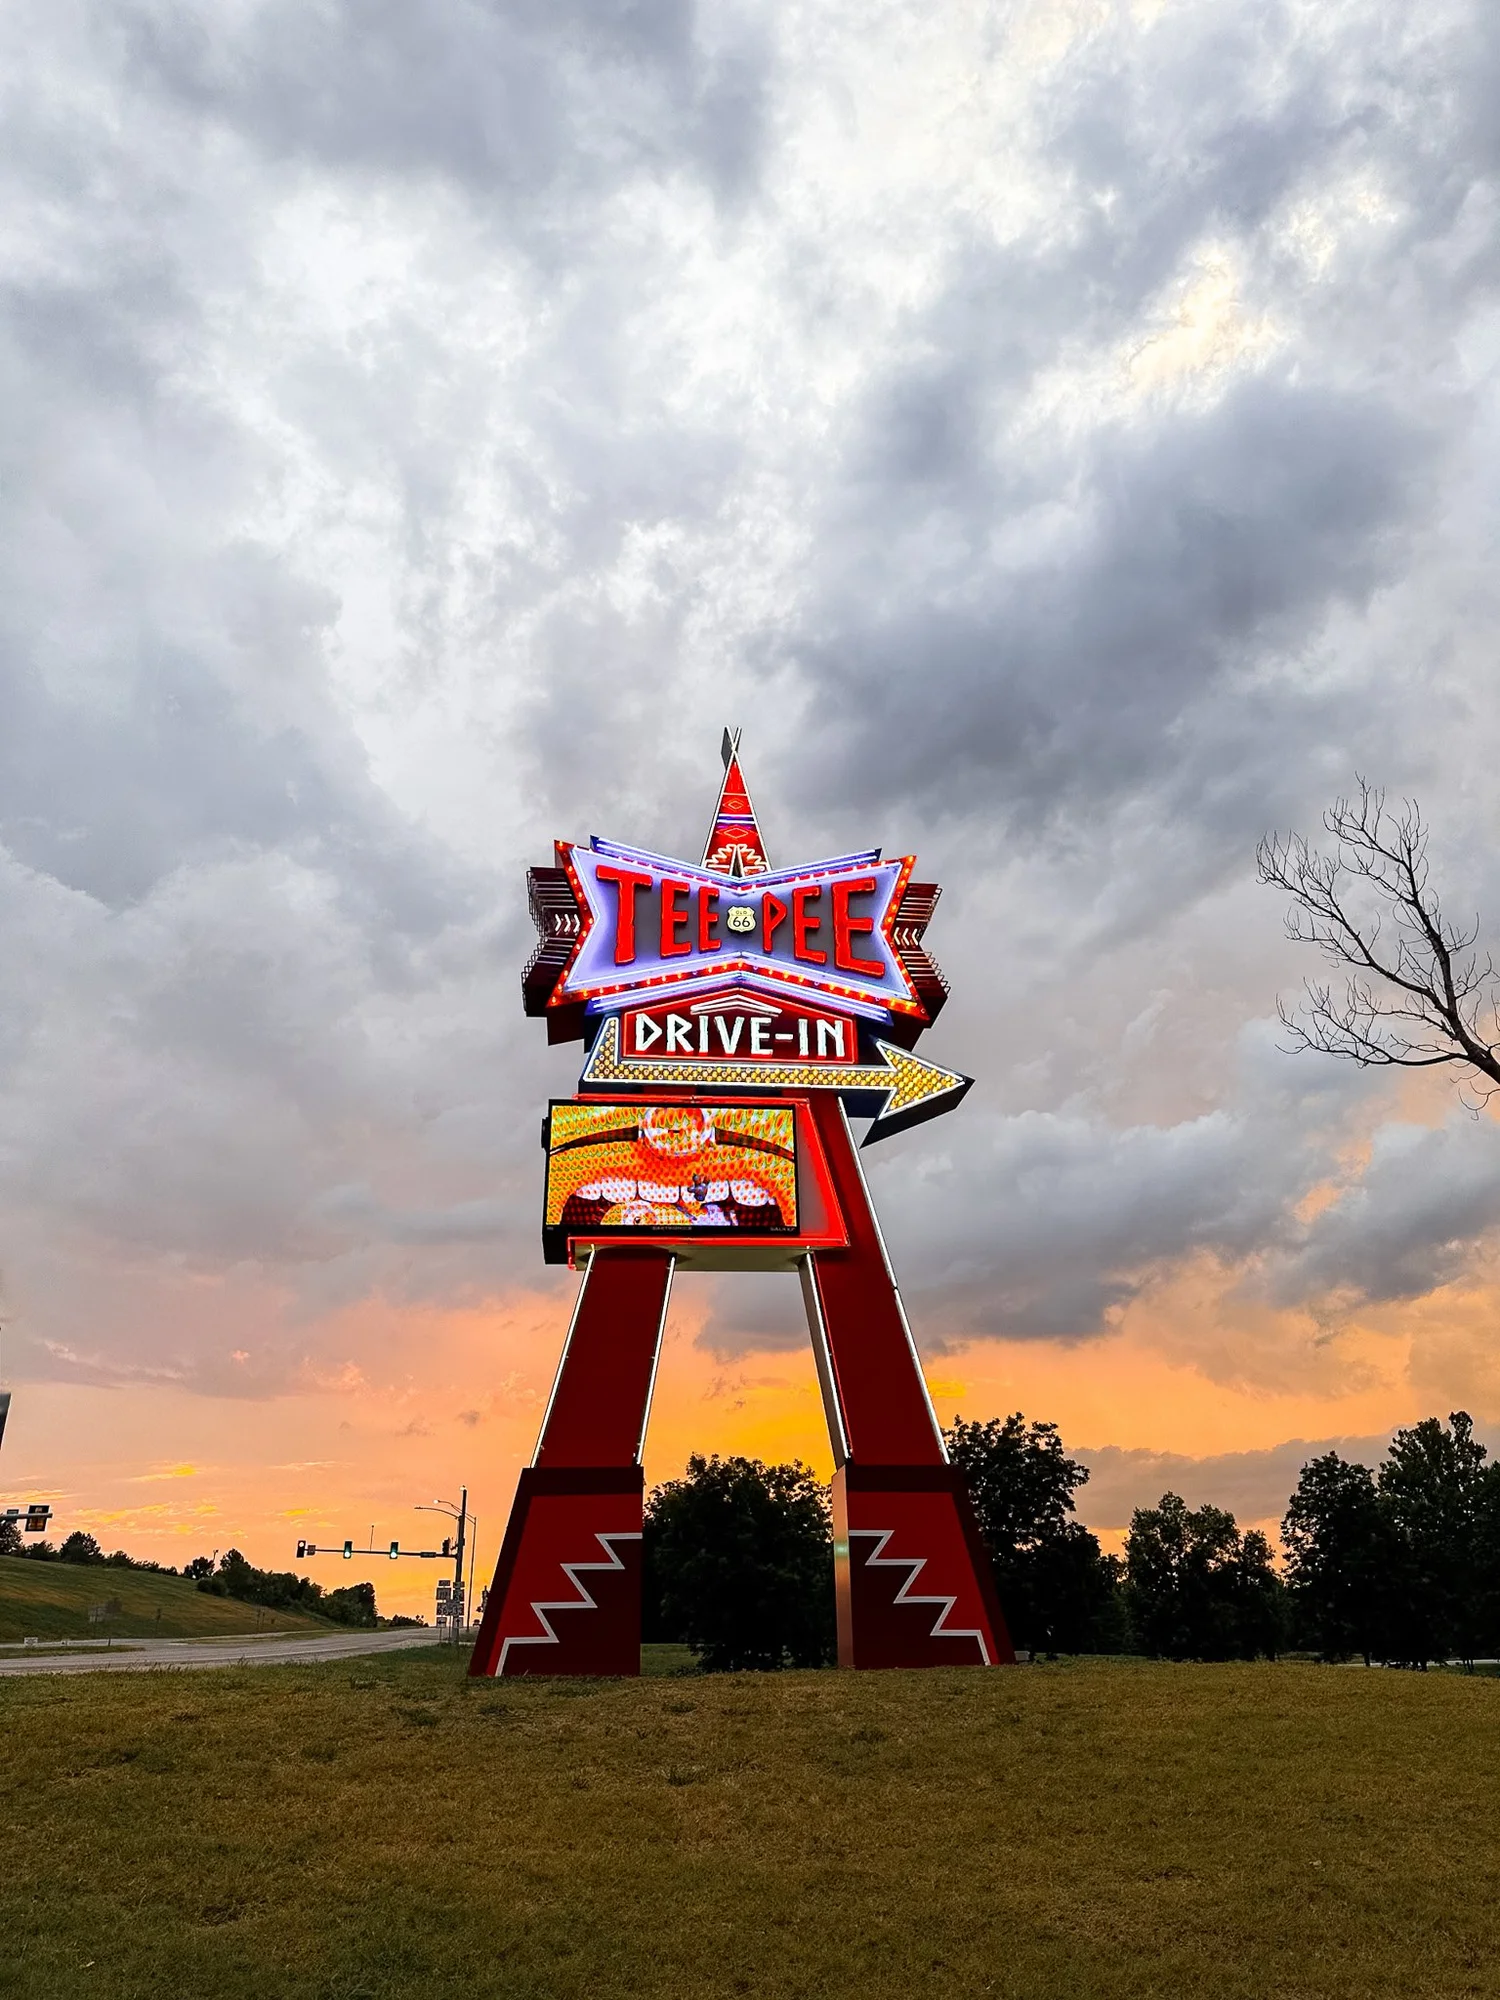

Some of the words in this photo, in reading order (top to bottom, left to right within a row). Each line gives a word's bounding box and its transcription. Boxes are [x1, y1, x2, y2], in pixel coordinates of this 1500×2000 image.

[595, 864, 722, 965] TEE
[761, 876, 886, 978] PEE
[732, 916, 751, 928] 66
[634, 1013, 845, 1058] DRIVE-IN
